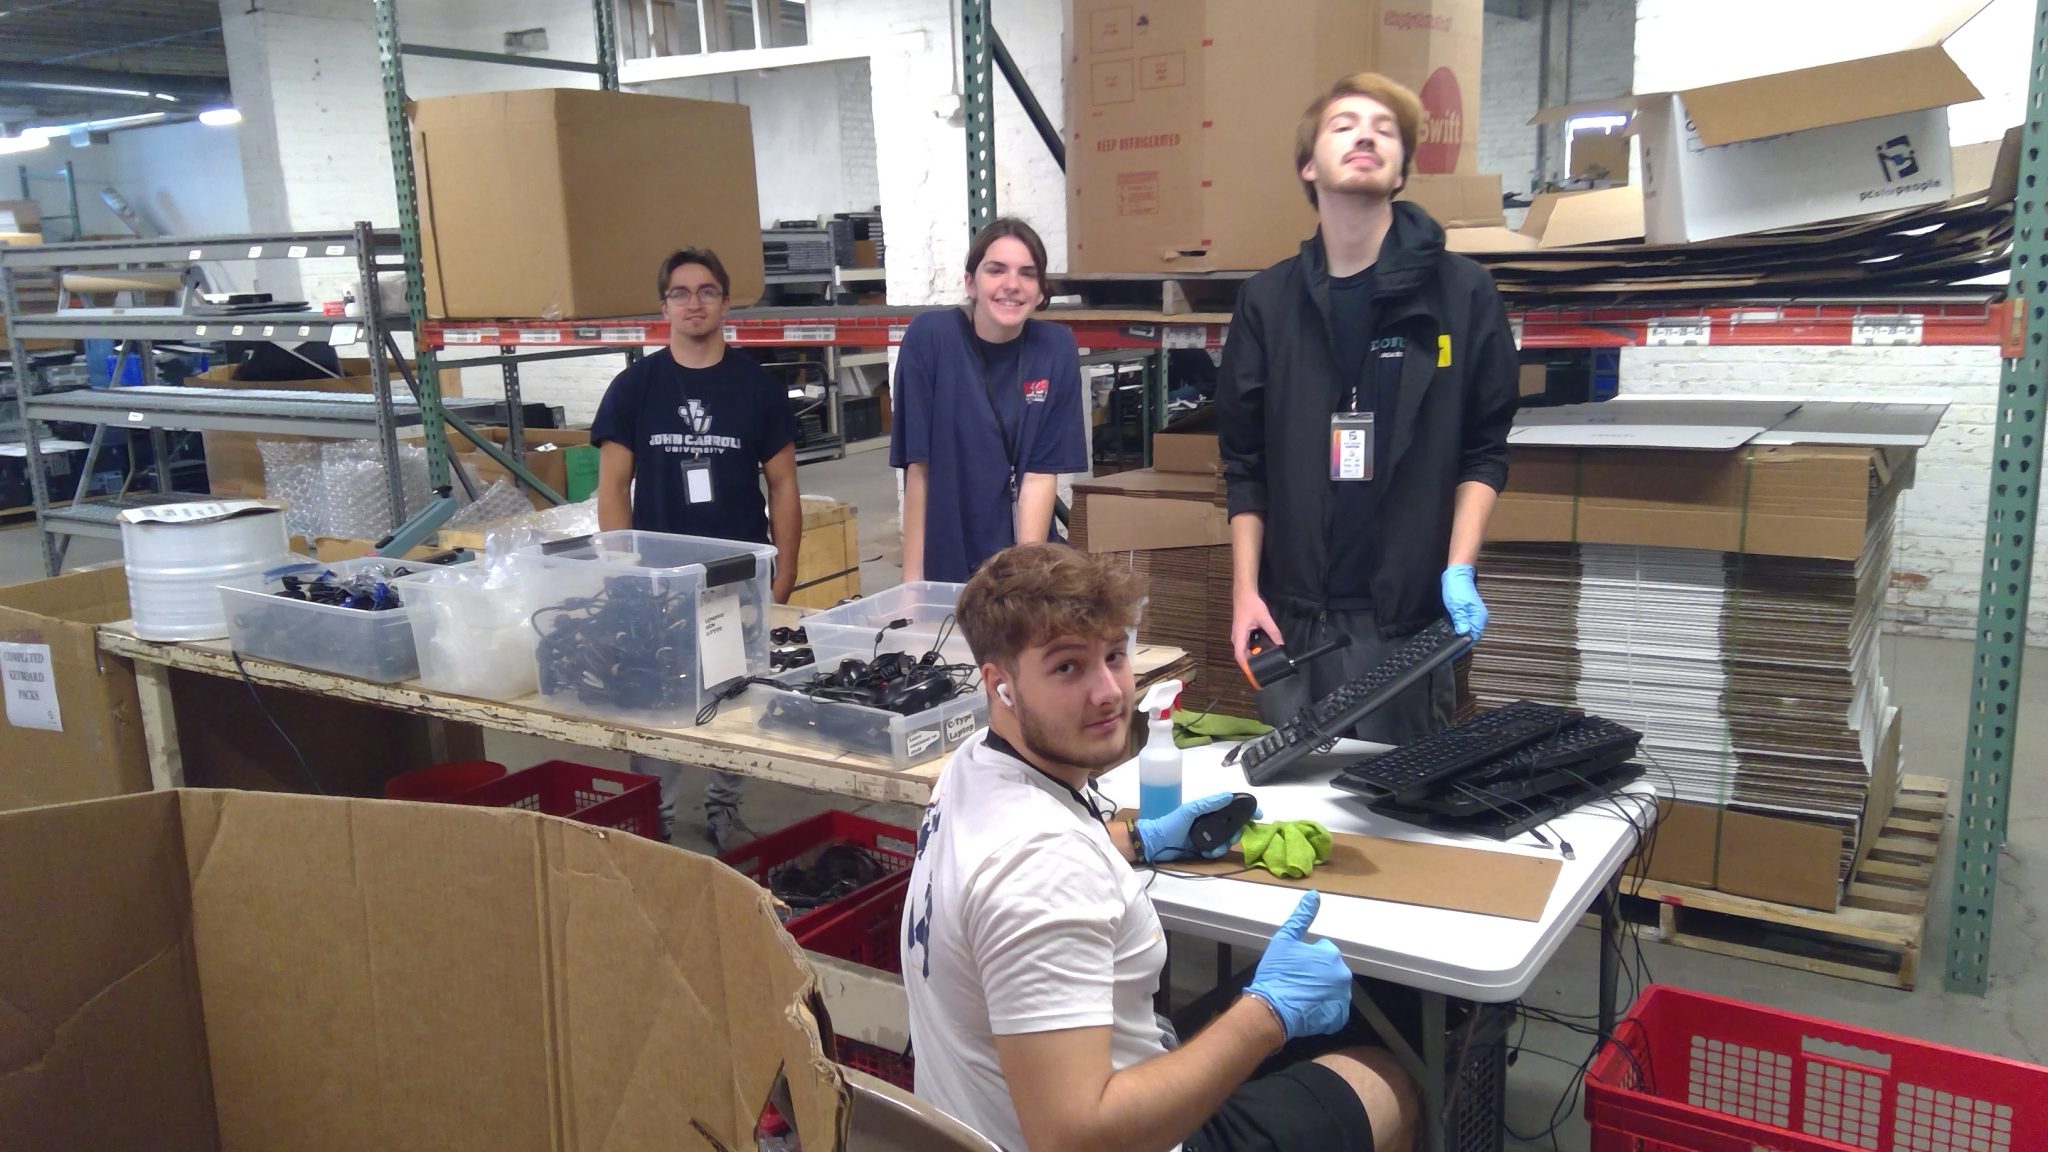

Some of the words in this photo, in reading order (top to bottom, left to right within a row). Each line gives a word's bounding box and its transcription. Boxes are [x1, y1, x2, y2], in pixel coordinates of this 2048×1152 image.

[1418, 109, 1461, 144] Swift
[1097, 139, 1117, 151] KEEP
[1120, 134, 1180, 150] REFRIGERATED
[649, 434, 683, 446] JOHN
[665, 446, 724, 454] UNIVERSITY
[949, 724, 974, 740] Laptop
